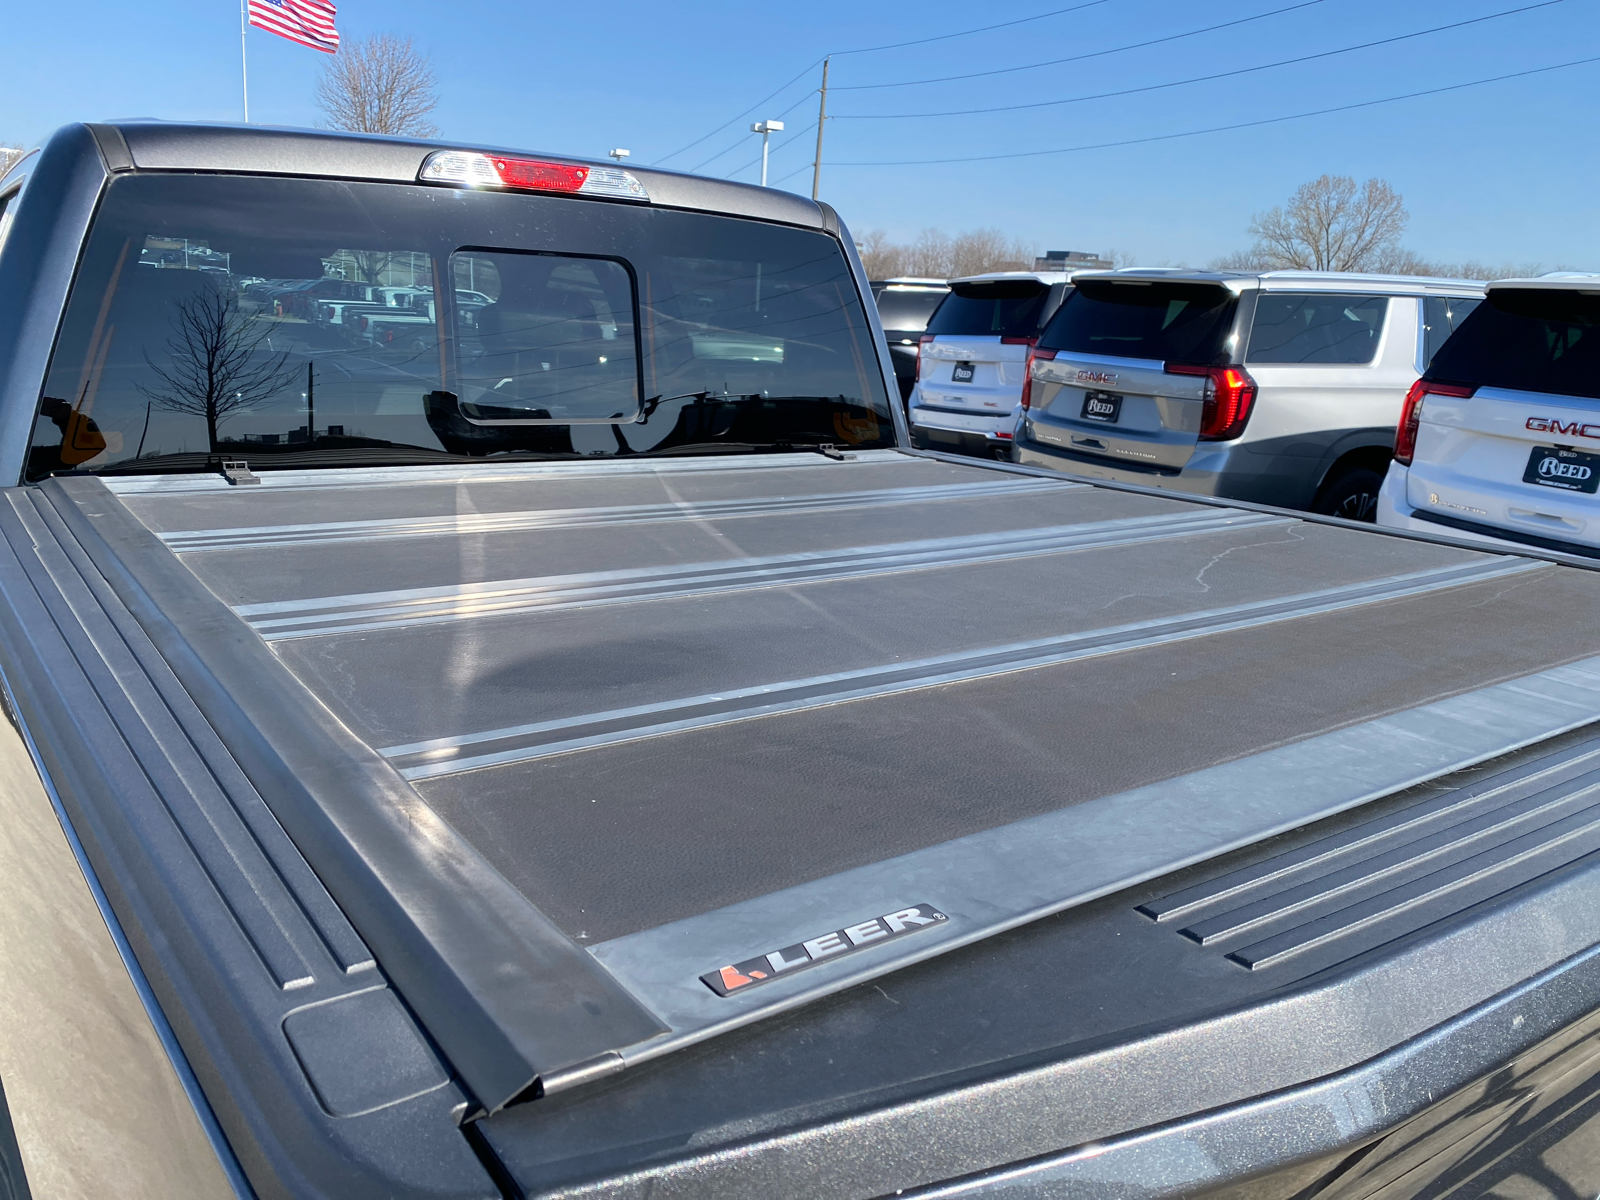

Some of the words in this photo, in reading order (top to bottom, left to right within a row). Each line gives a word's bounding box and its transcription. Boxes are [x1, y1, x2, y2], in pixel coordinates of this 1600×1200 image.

[1078, 370, 1119, 385] GMC
[1087, 398, 1114, 414] REED
[1525, 416, 1600, 440] GMC
[1538, 456, 1592, 480] REED
[764, 907, 936, 973] LEER
